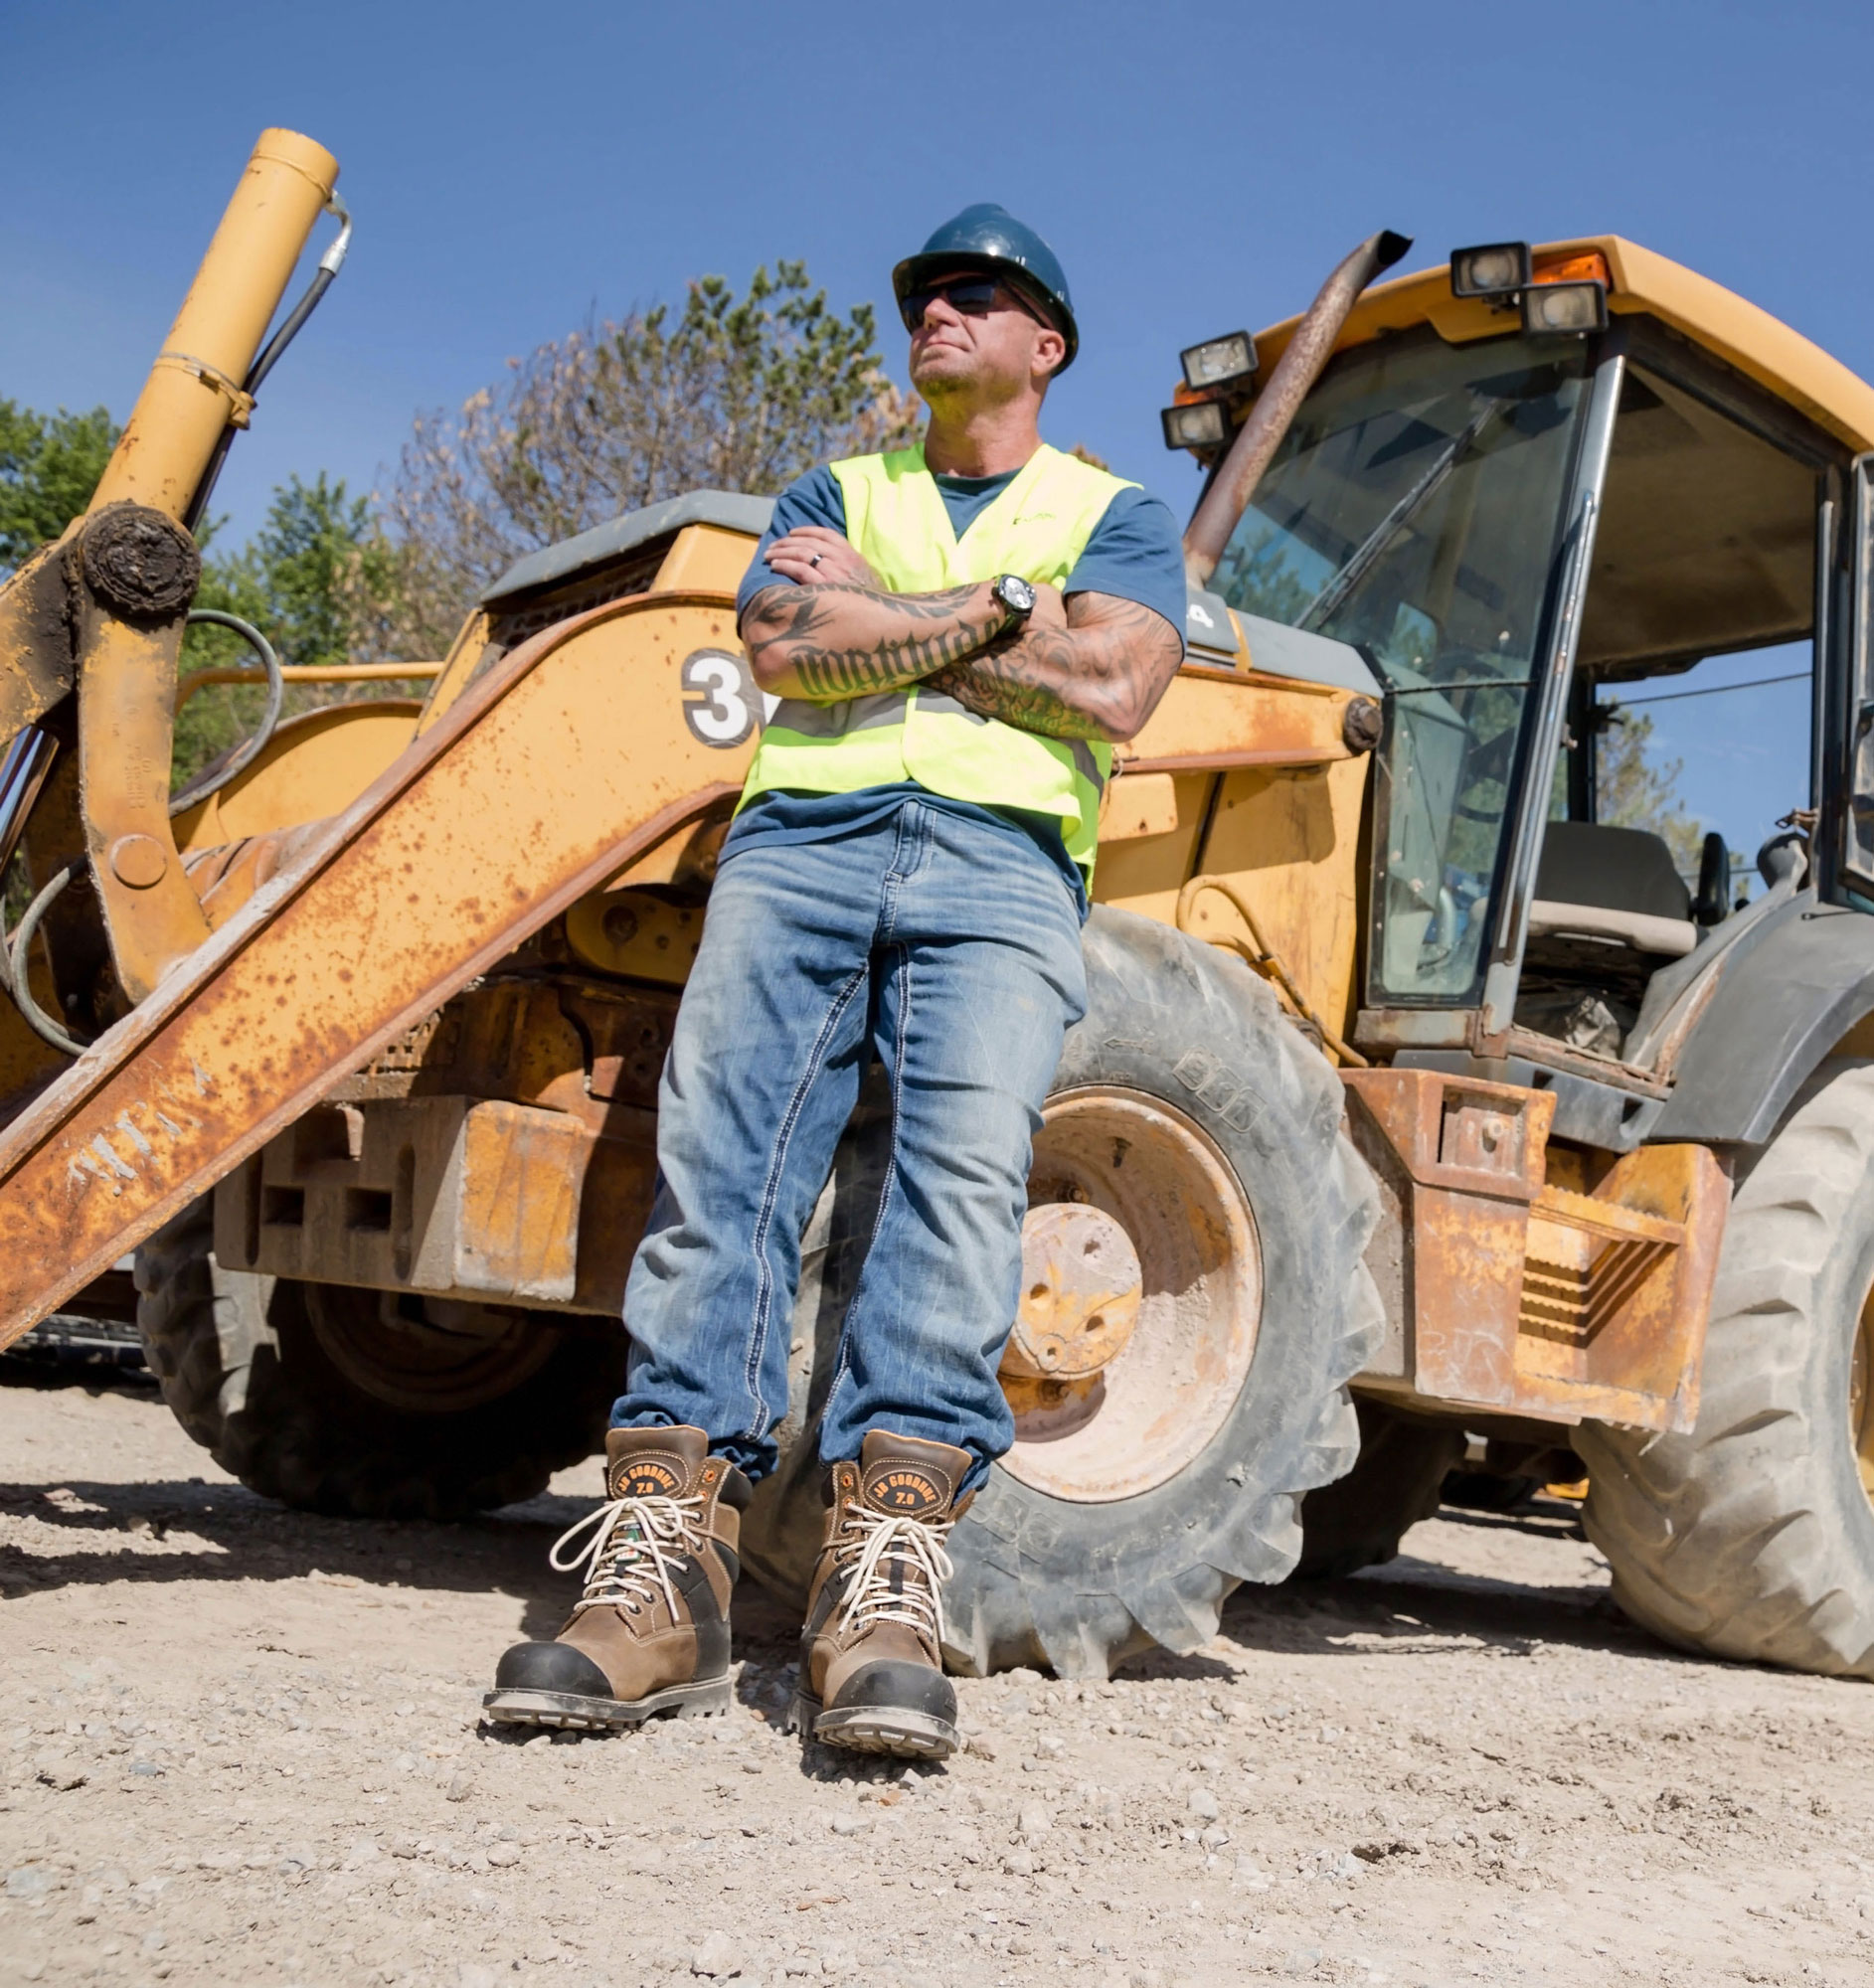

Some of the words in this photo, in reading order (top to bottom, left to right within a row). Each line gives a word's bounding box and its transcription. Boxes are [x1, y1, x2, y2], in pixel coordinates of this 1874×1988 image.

[688, 656, 782, 741] 3
[618, 1476, 630, 1492] JB
[629, 1464, 675, 1489] GOODHUE
[636, 1482, 654, 1494] 7.0
[874, 1482, 889, 1498] JB
[889, 1474, 937, 1503] GOODHUE
[896, 1492, 915, 1505] 7.0
